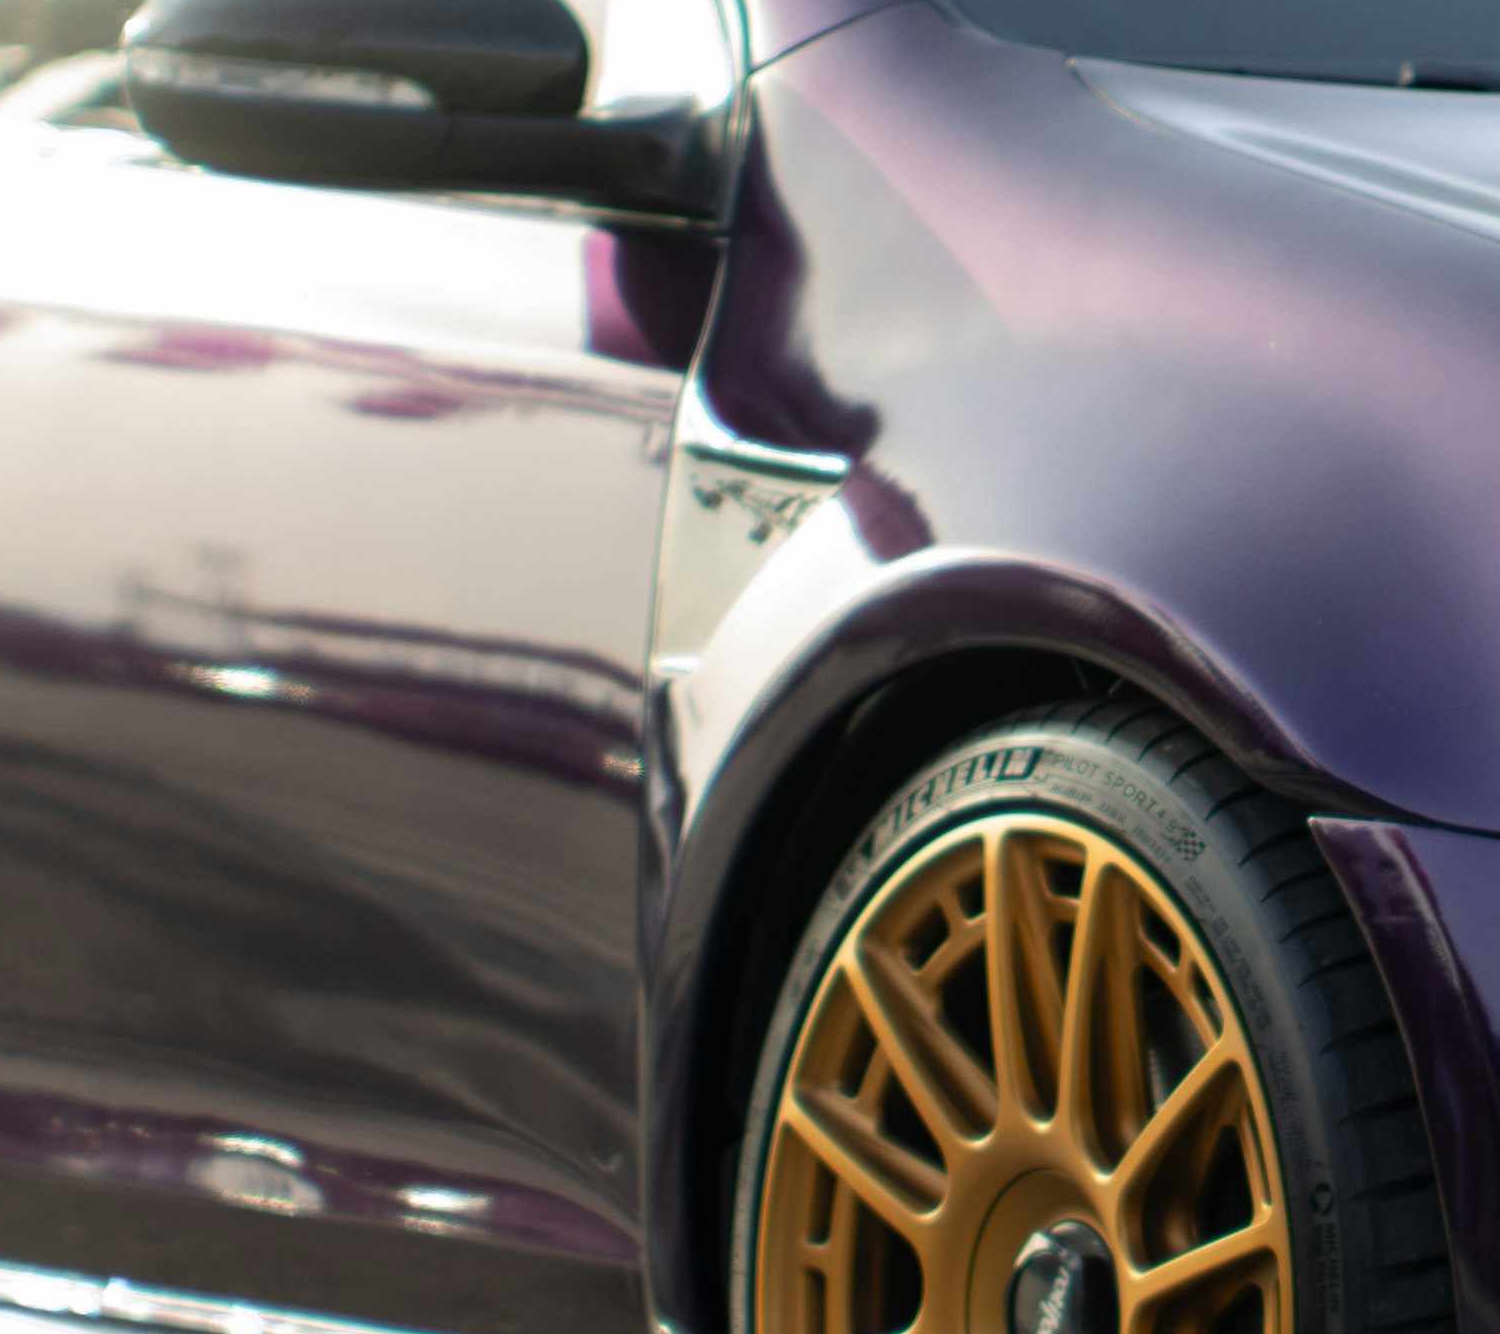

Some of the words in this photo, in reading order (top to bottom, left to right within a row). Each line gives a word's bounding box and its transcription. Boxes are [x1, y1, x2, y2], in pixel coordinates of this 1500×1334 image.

[868, 745, 1040, 859] MICHELIN
[1052, 751, 1100, 779] PILOT
[1102, 771, 1158, 814] SPORT
[1326, 1223, 1341, 1313] MICHELIN
